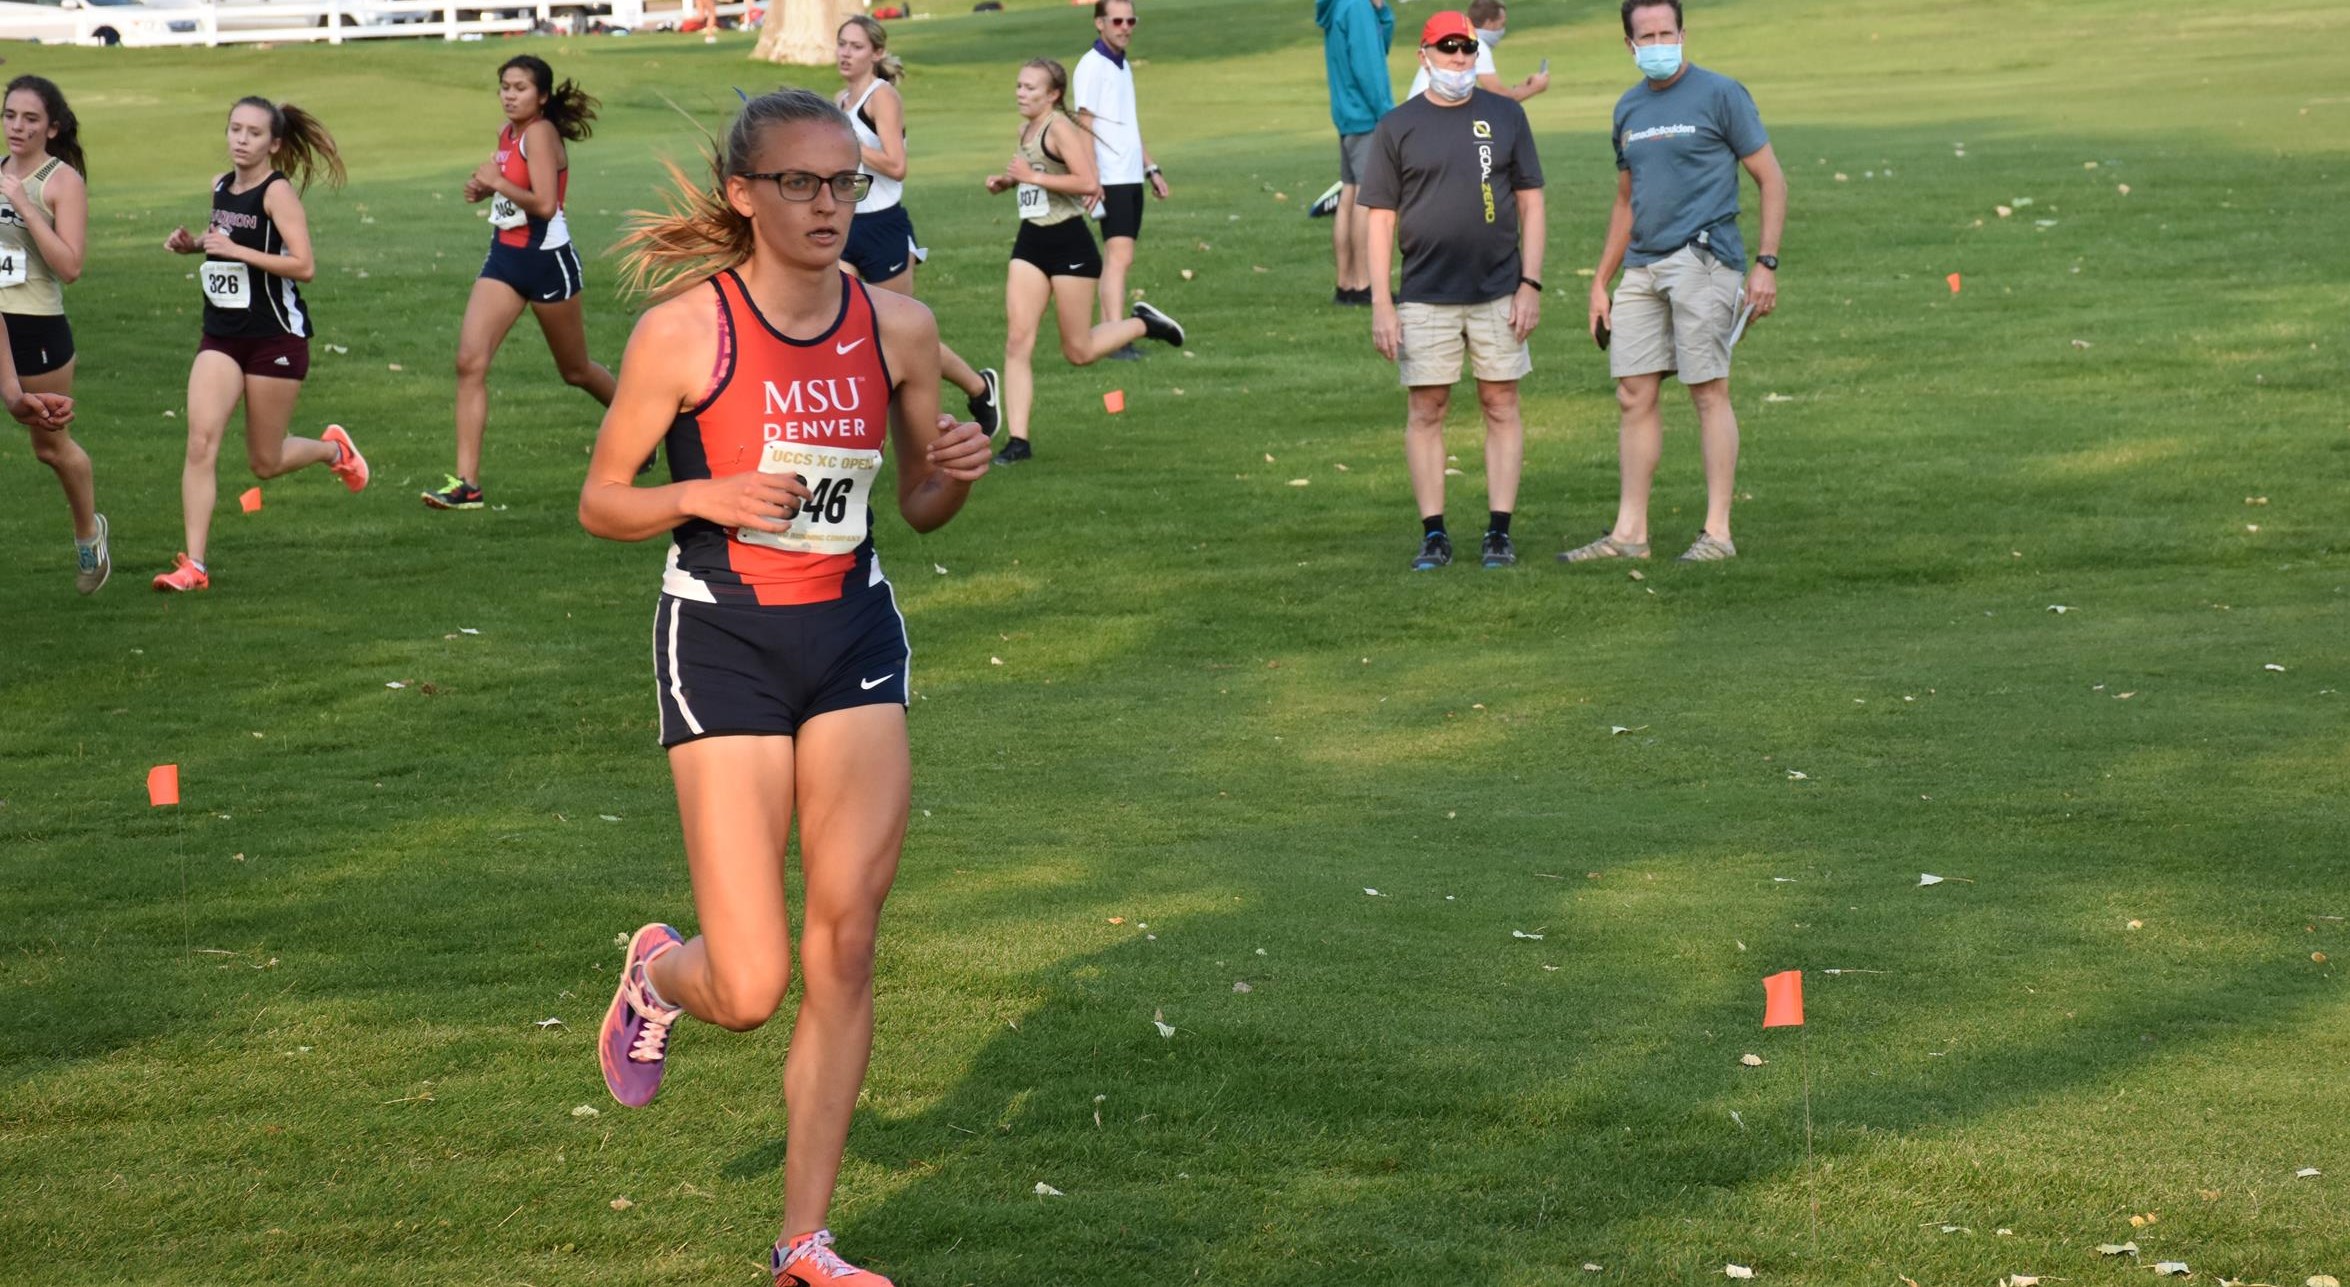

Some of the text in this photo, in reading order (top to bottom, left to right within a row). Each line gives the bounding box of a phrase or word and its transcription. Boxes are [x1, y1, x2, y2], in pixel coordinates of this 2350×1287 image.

[1479, 145, 1495, 223] GOAL ZERO
[209, 274, 239, 294] 326
[763, 377, 860, 414] MSU
[763, 418, 865, 441] DENVER
[772, 450, 875, 470] UCCS XC OPEN
